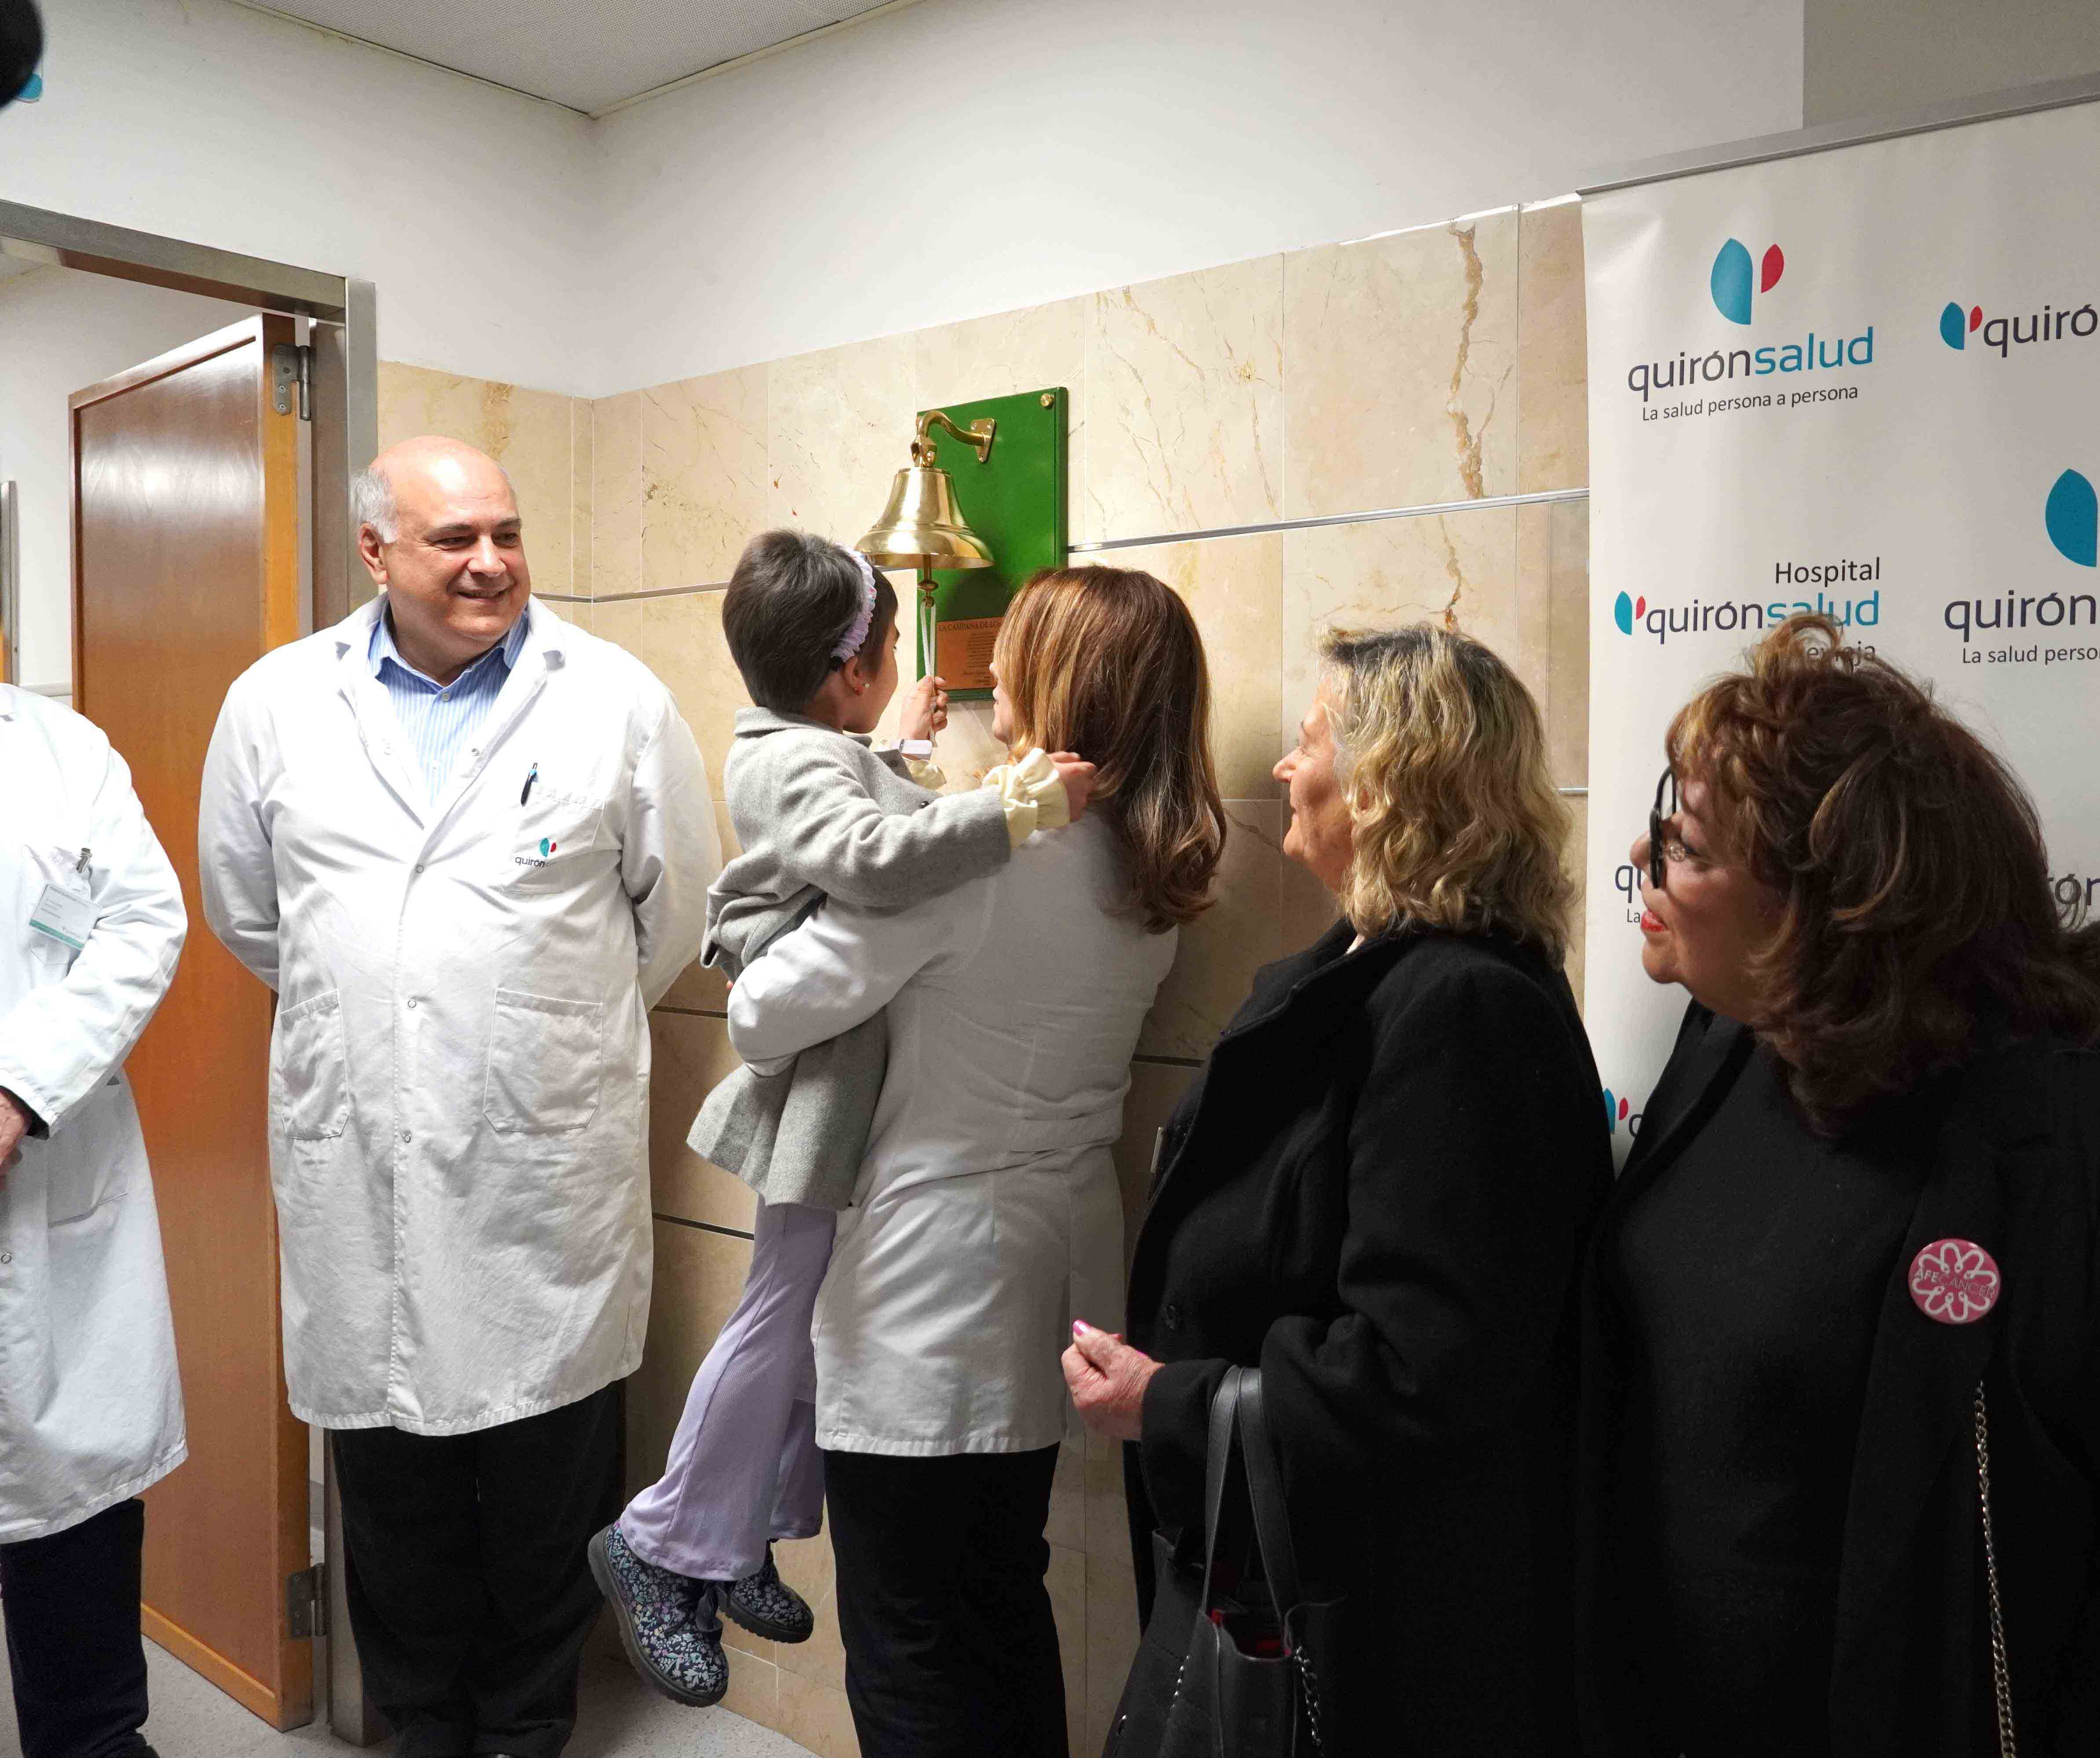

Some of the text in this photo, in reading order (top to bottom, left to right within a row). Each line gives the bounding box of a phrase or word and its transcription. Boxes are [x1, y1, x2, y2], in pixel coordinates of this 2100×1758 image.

[1628, 326, 1873, 402] quirónsalud
[1642, 387, 1858, 421] La salud persona a persona
[1775, 556, 1880, 587] Hospital
[948, 622, 979, 631] CAMPANA
[1962, 644, 2100, 665] La salud perso
[1627, 908, 1640, 923] La
